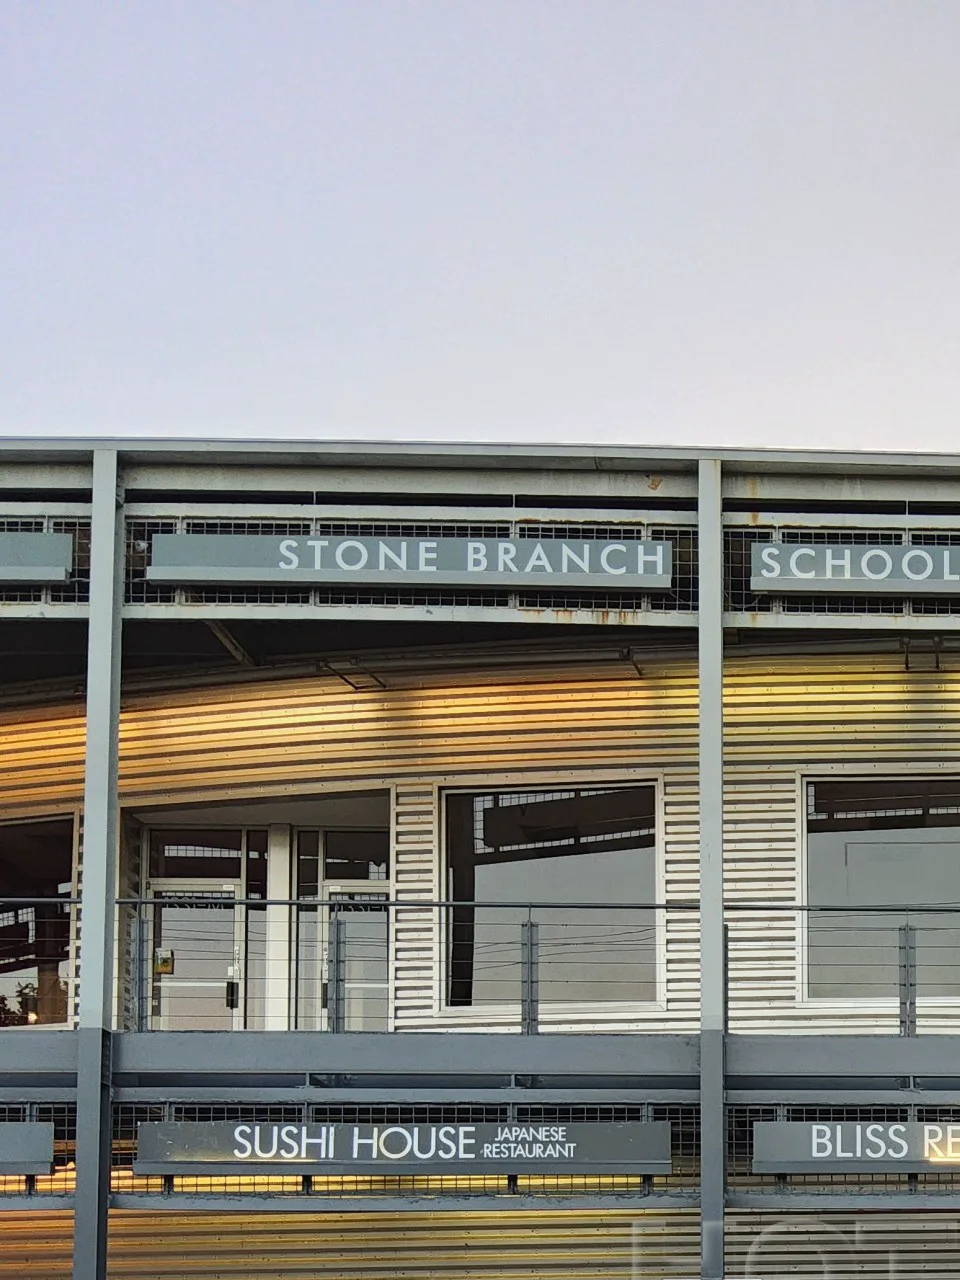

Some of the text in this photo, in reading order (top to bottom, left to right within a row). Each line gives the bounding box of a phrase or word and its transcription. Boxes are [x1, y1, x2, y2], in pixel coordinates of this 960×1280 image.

[279, 539, 439, 572] STONE
[466, 541, 665, 576] BRANCH
[761, 548, 960, 580] SCHOOL
[233, 1125, 476, 1159] SUSHI HOUSE
[483, 1143, 577, 1159] RESTAURANT
[494, 1127, 567, 1141] JAPANESE
[811, 1123, 908, 1159] BLISS
